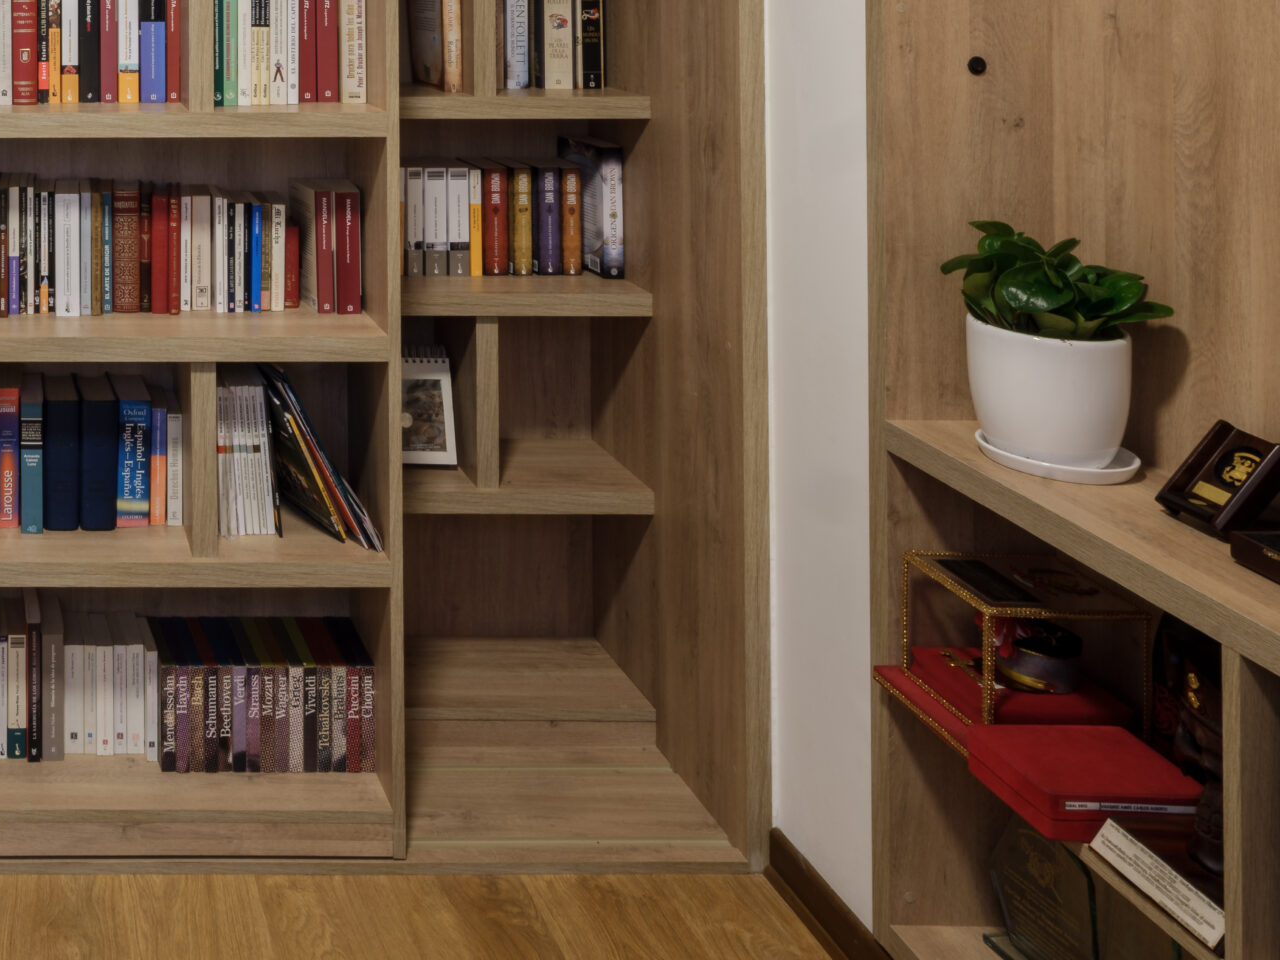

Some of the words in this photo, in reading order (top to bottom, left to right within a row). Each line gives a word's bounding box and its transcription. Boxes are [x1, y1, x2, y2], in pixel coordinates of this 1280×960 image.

[516, 21, 526, 65] FOLLETT
[491, 173, 500, 192] BROWN
[491, 192, 500, 204] DAN
[519, 173, 528, 193] BROWN
[519, 193, 528, 204] DAN
[545, 172, 554, 191] BROWN
[545, 192, 554, 203] DAN
[567, 173, 576, 193] BROWN
[567, 193, 576, 204] DAN
[609, 168, 617, 194] BROWN
[609, 195, 617, 211] DAN
[609, 220, 618, 250] ORIGEN
[1, 470, 13, 520] Larousse
[176, 676, 188, 714] Haydn
[191, 676, 203, 705] Bach
[206, 675, 217, 738] Schumann
[220, 675, 231, 737] Beethoven
[234, 675, 245, 705] Verdi
[249, 675, 259, 718] Strauss
[262, 675, 273, 717] Mozart
[276, 674, 288, 719] Wagner
[291, 675, 303, 708] Grieg
[305, 675, 316, 715] Vivaldi
[334, 675, 344, 721] Brahms
[348, 675, 359, 719] Puccini
[362, 675, 374, 718] Chopin
[164, 676, 175, 752] Mendelssohn
[318, 677, 330, 750] Tchaikovsky
